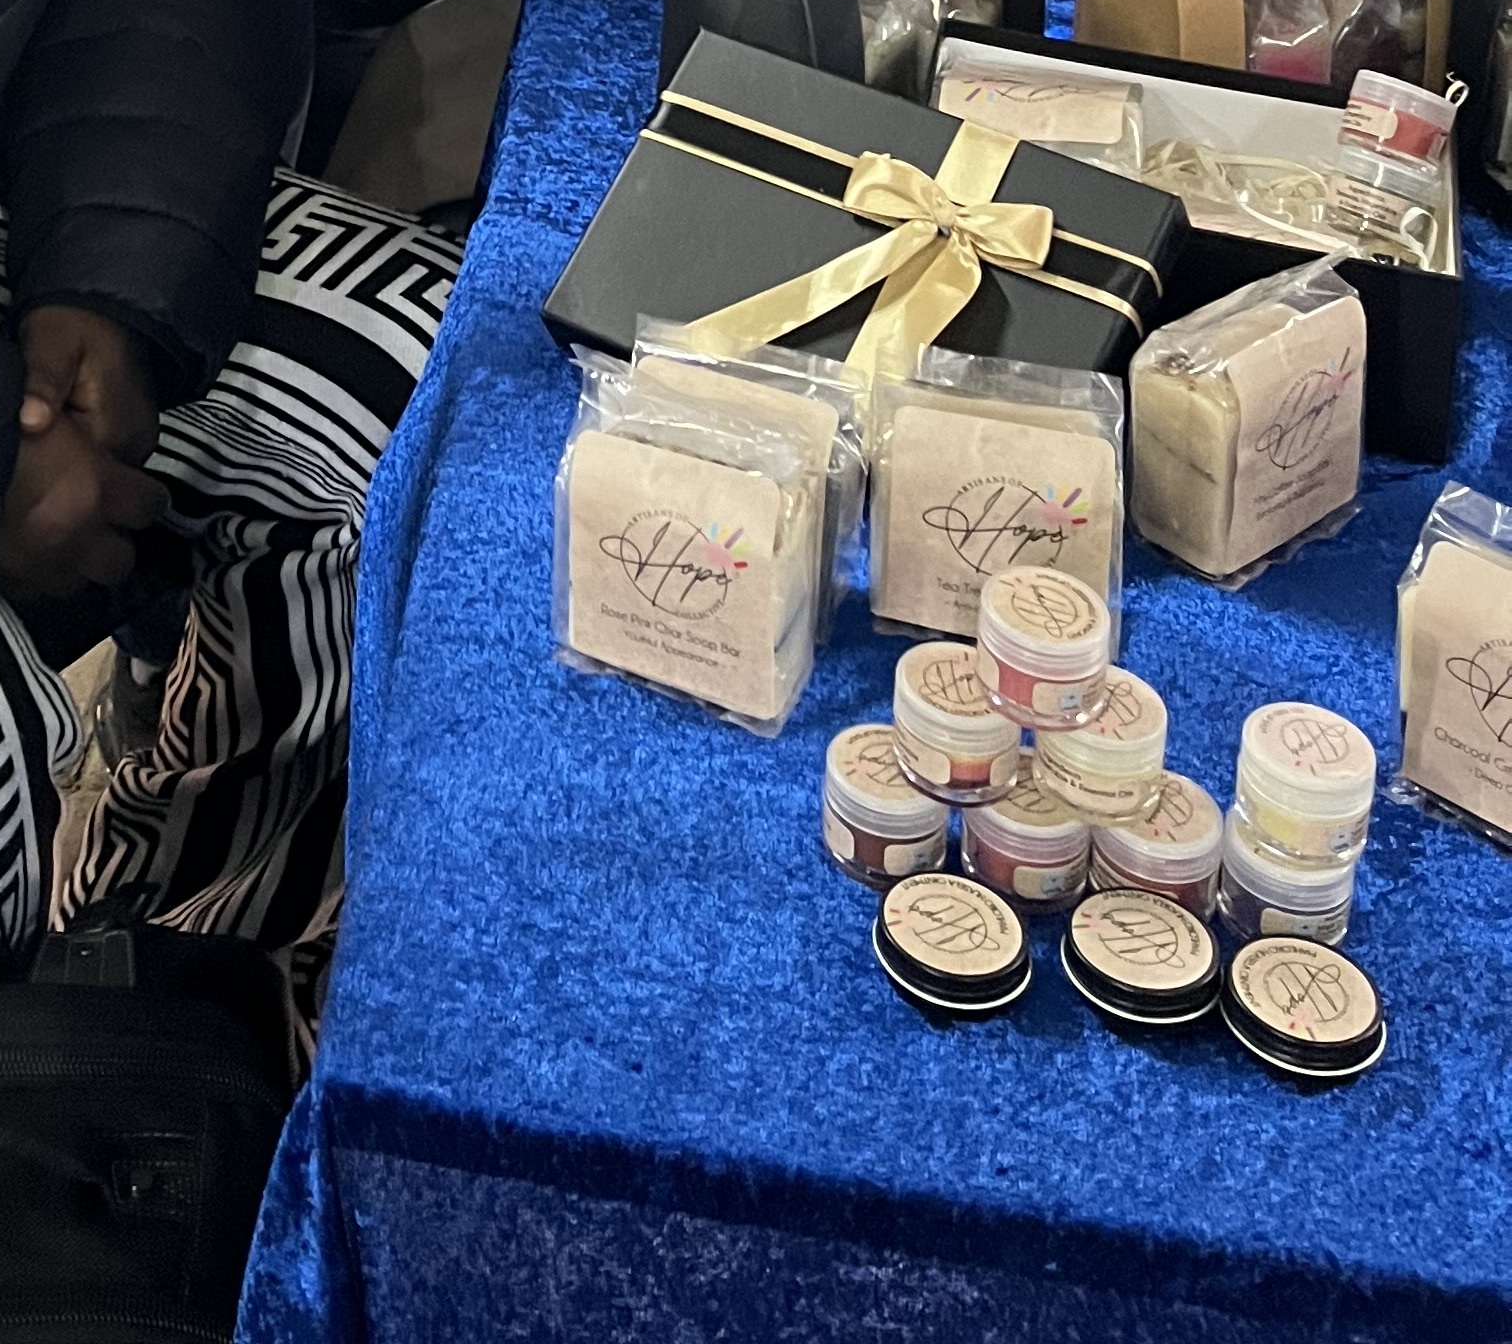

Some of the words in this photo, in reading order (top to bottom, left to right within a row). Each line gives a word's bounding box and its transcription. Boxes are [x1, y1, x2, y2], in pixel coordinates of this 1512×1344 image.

[922, 486, 1070, 573] Hope
[599, 521, 733, 606] Hope
[963, 582, 982, 598] Tre
[600, 602, 628, 622] Rose
[686, 630, 718, 652] Soap
[720, 642, 741, 658] Bar
[1434, 726, 1492, 765] Charcoal
